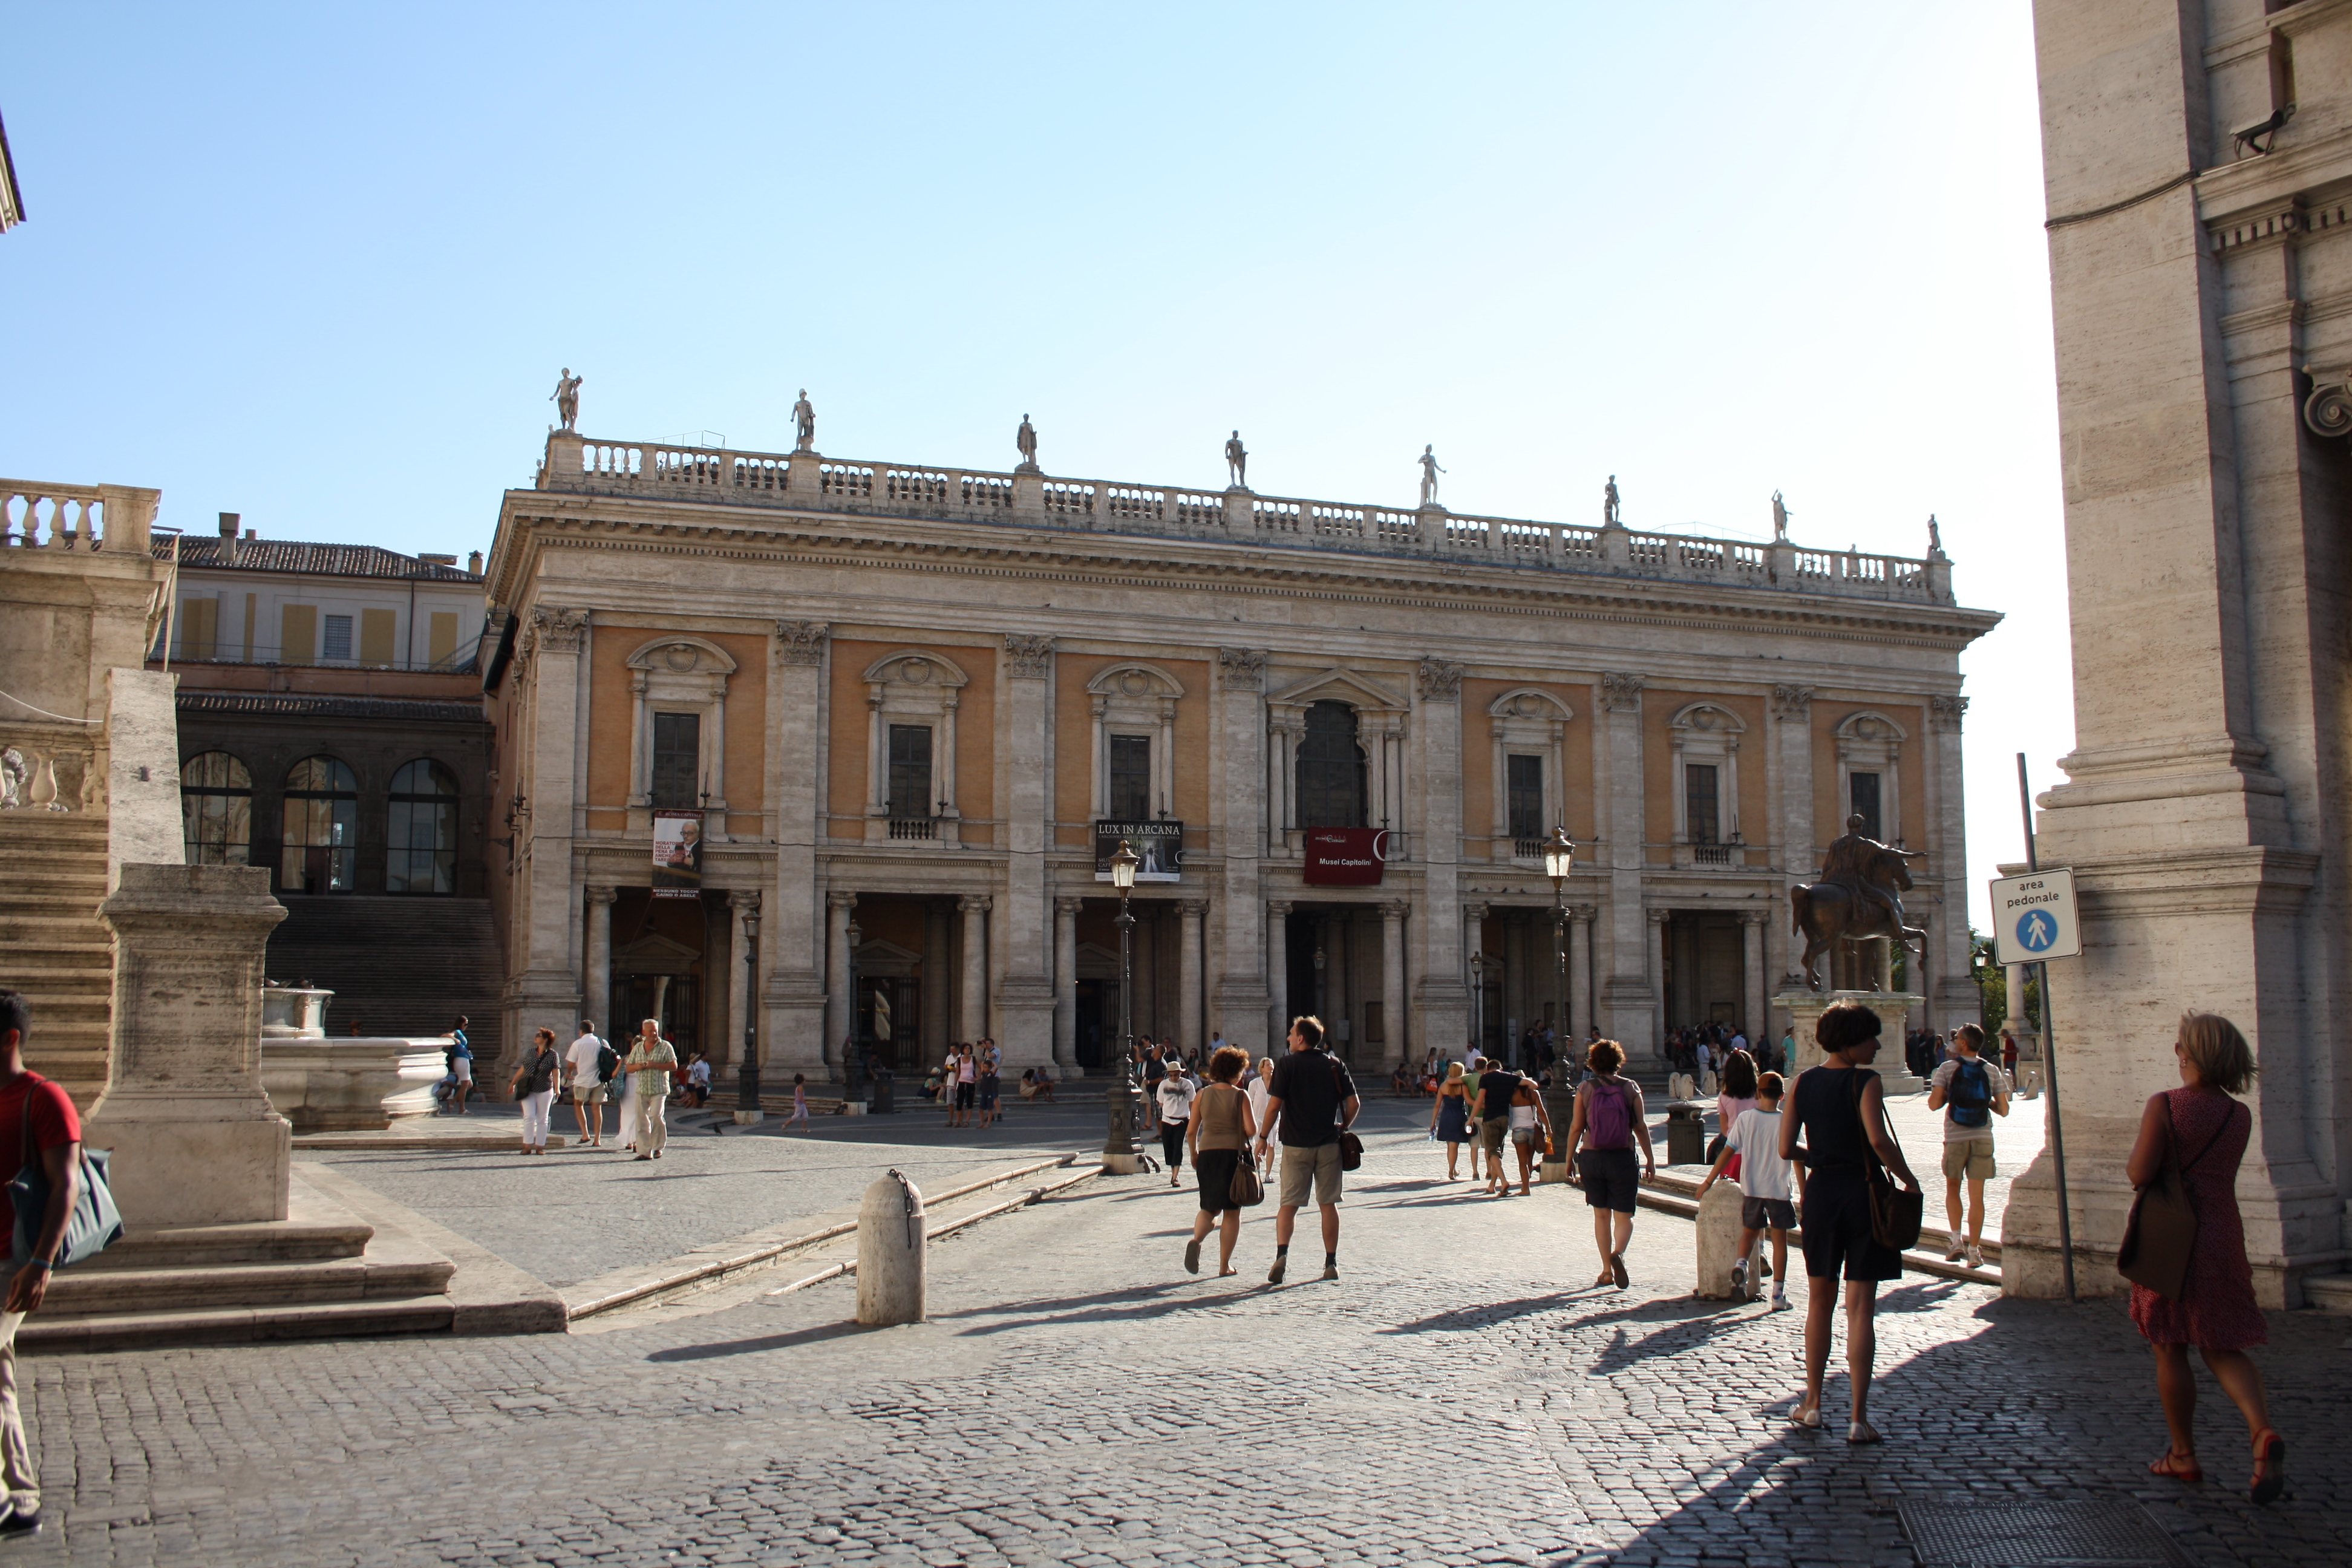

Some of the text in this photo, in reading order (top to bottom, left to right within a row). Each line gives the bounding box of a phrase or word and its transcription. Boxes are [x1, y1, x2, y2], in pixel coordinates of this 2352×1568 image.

[1099, 825, 1180, 835] LUX IN ARCANA
[2019, 880, 2043, 891] area
[2007, 892, 2059, 909] pedonale
